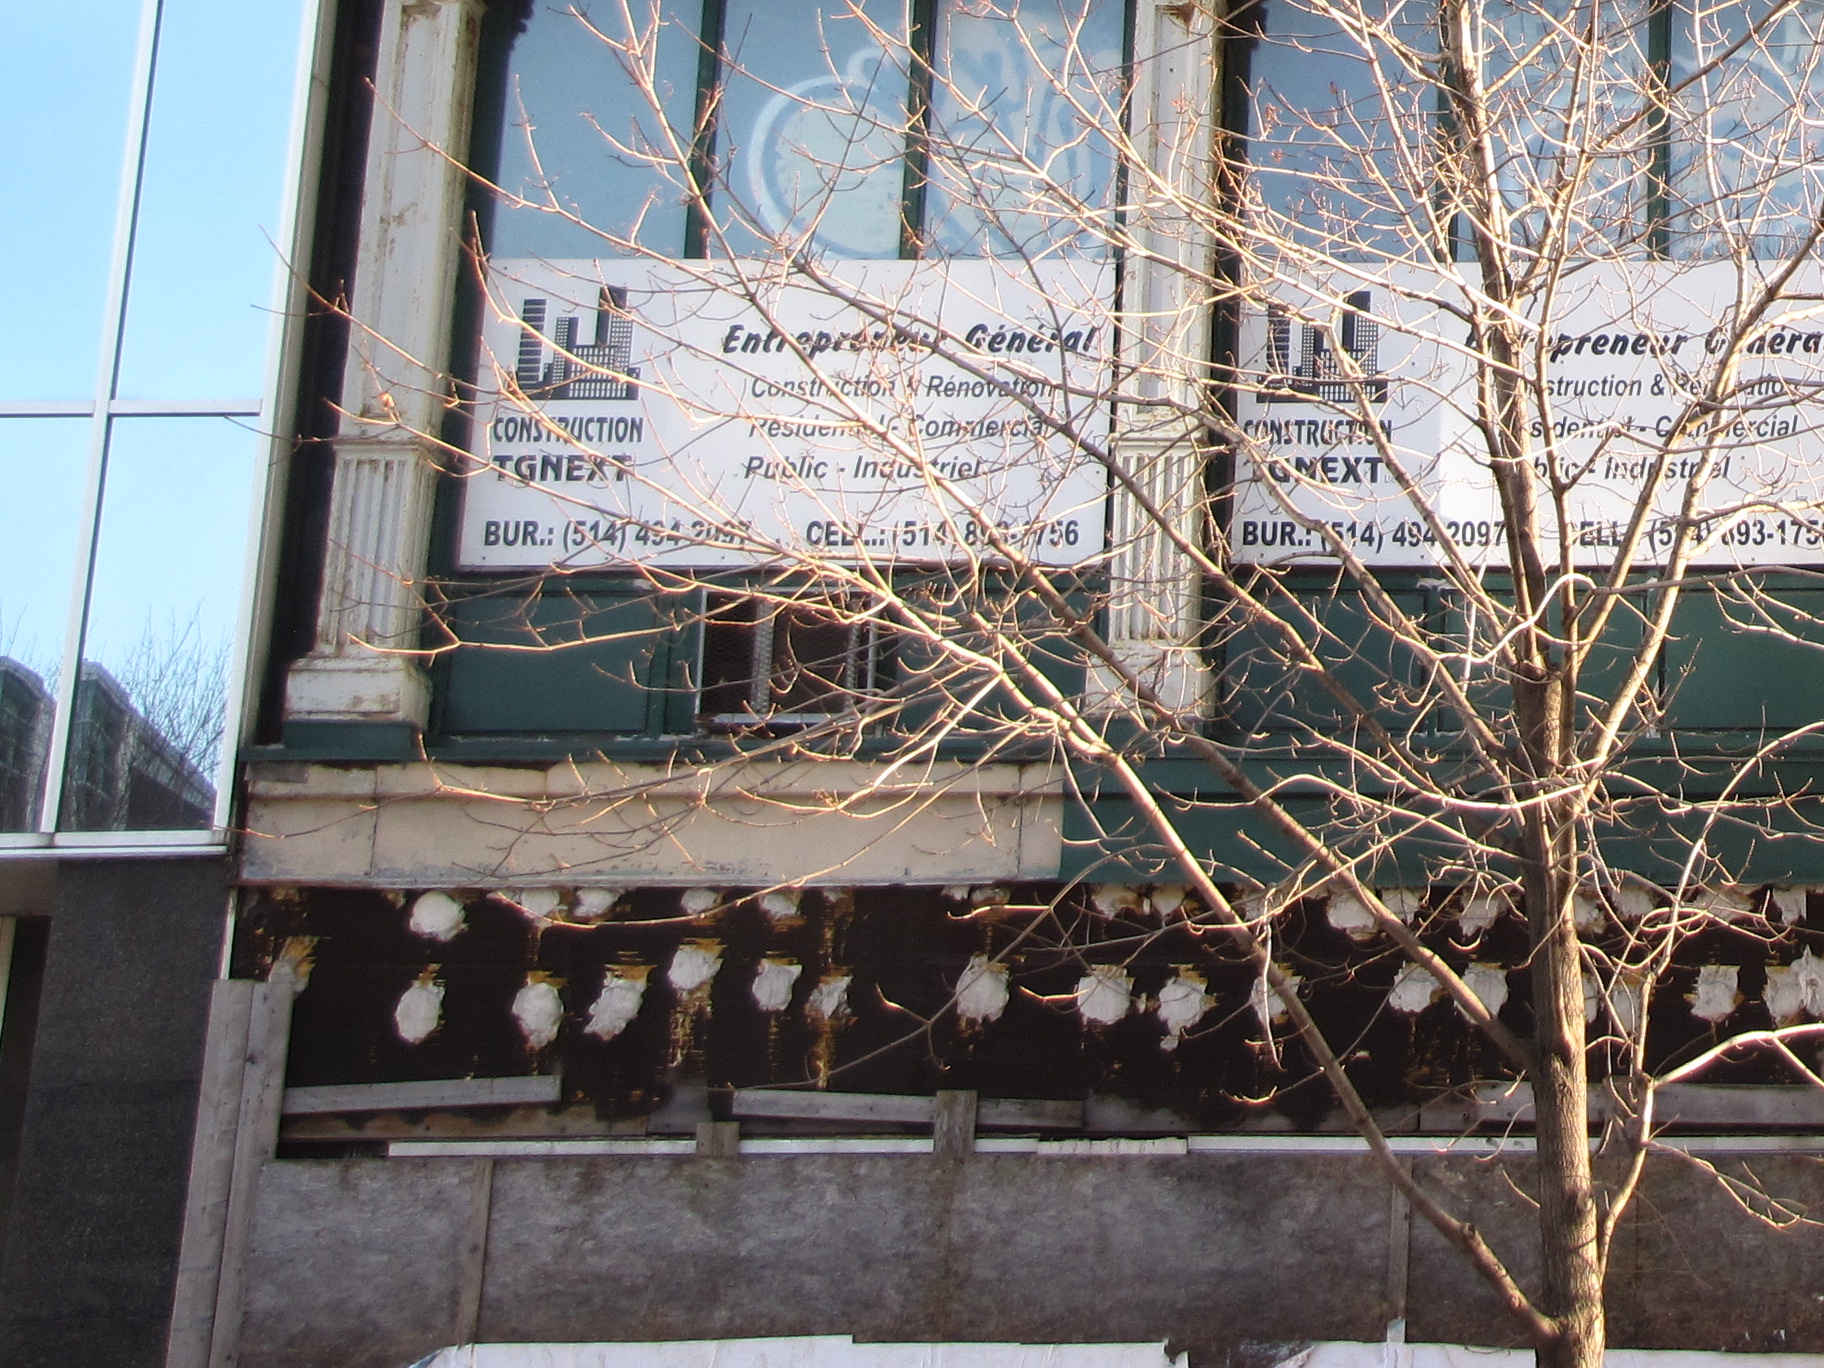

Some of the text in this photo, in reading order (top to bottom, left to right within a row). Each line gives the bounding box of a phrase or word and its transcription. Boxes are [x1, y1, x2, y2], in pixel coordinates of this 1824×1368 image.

[722, 324, 1099, 361] Entrepre Général
[1510, 374, 1643, 397] struction
[1651, 373, 1665, 396] &
[494, 416, 644, 445] CONSTRUCTION
[912, 413, 1049, 439] ommercia
[1655, 414, 1799, 438] Cmercial
[493, 455, 632, 482] TGNEXT
[744, 455, 828, 480] Public
[1258, 456, 1384, 483] GNEXT
[1604, 456, 1731, 479] Indstrel
[484, 520, 554, 546] BUR.:
[563, 519, 627, 553] (514)
[635, 520, 753, 547] 4942097
[964, 518, 1079, 547] 83-756
[1242, 520, 1312, 546] BUR.:
[1320, 520, 1384, 553] (514)
[1392, 520, 1504, 547] 4942097
